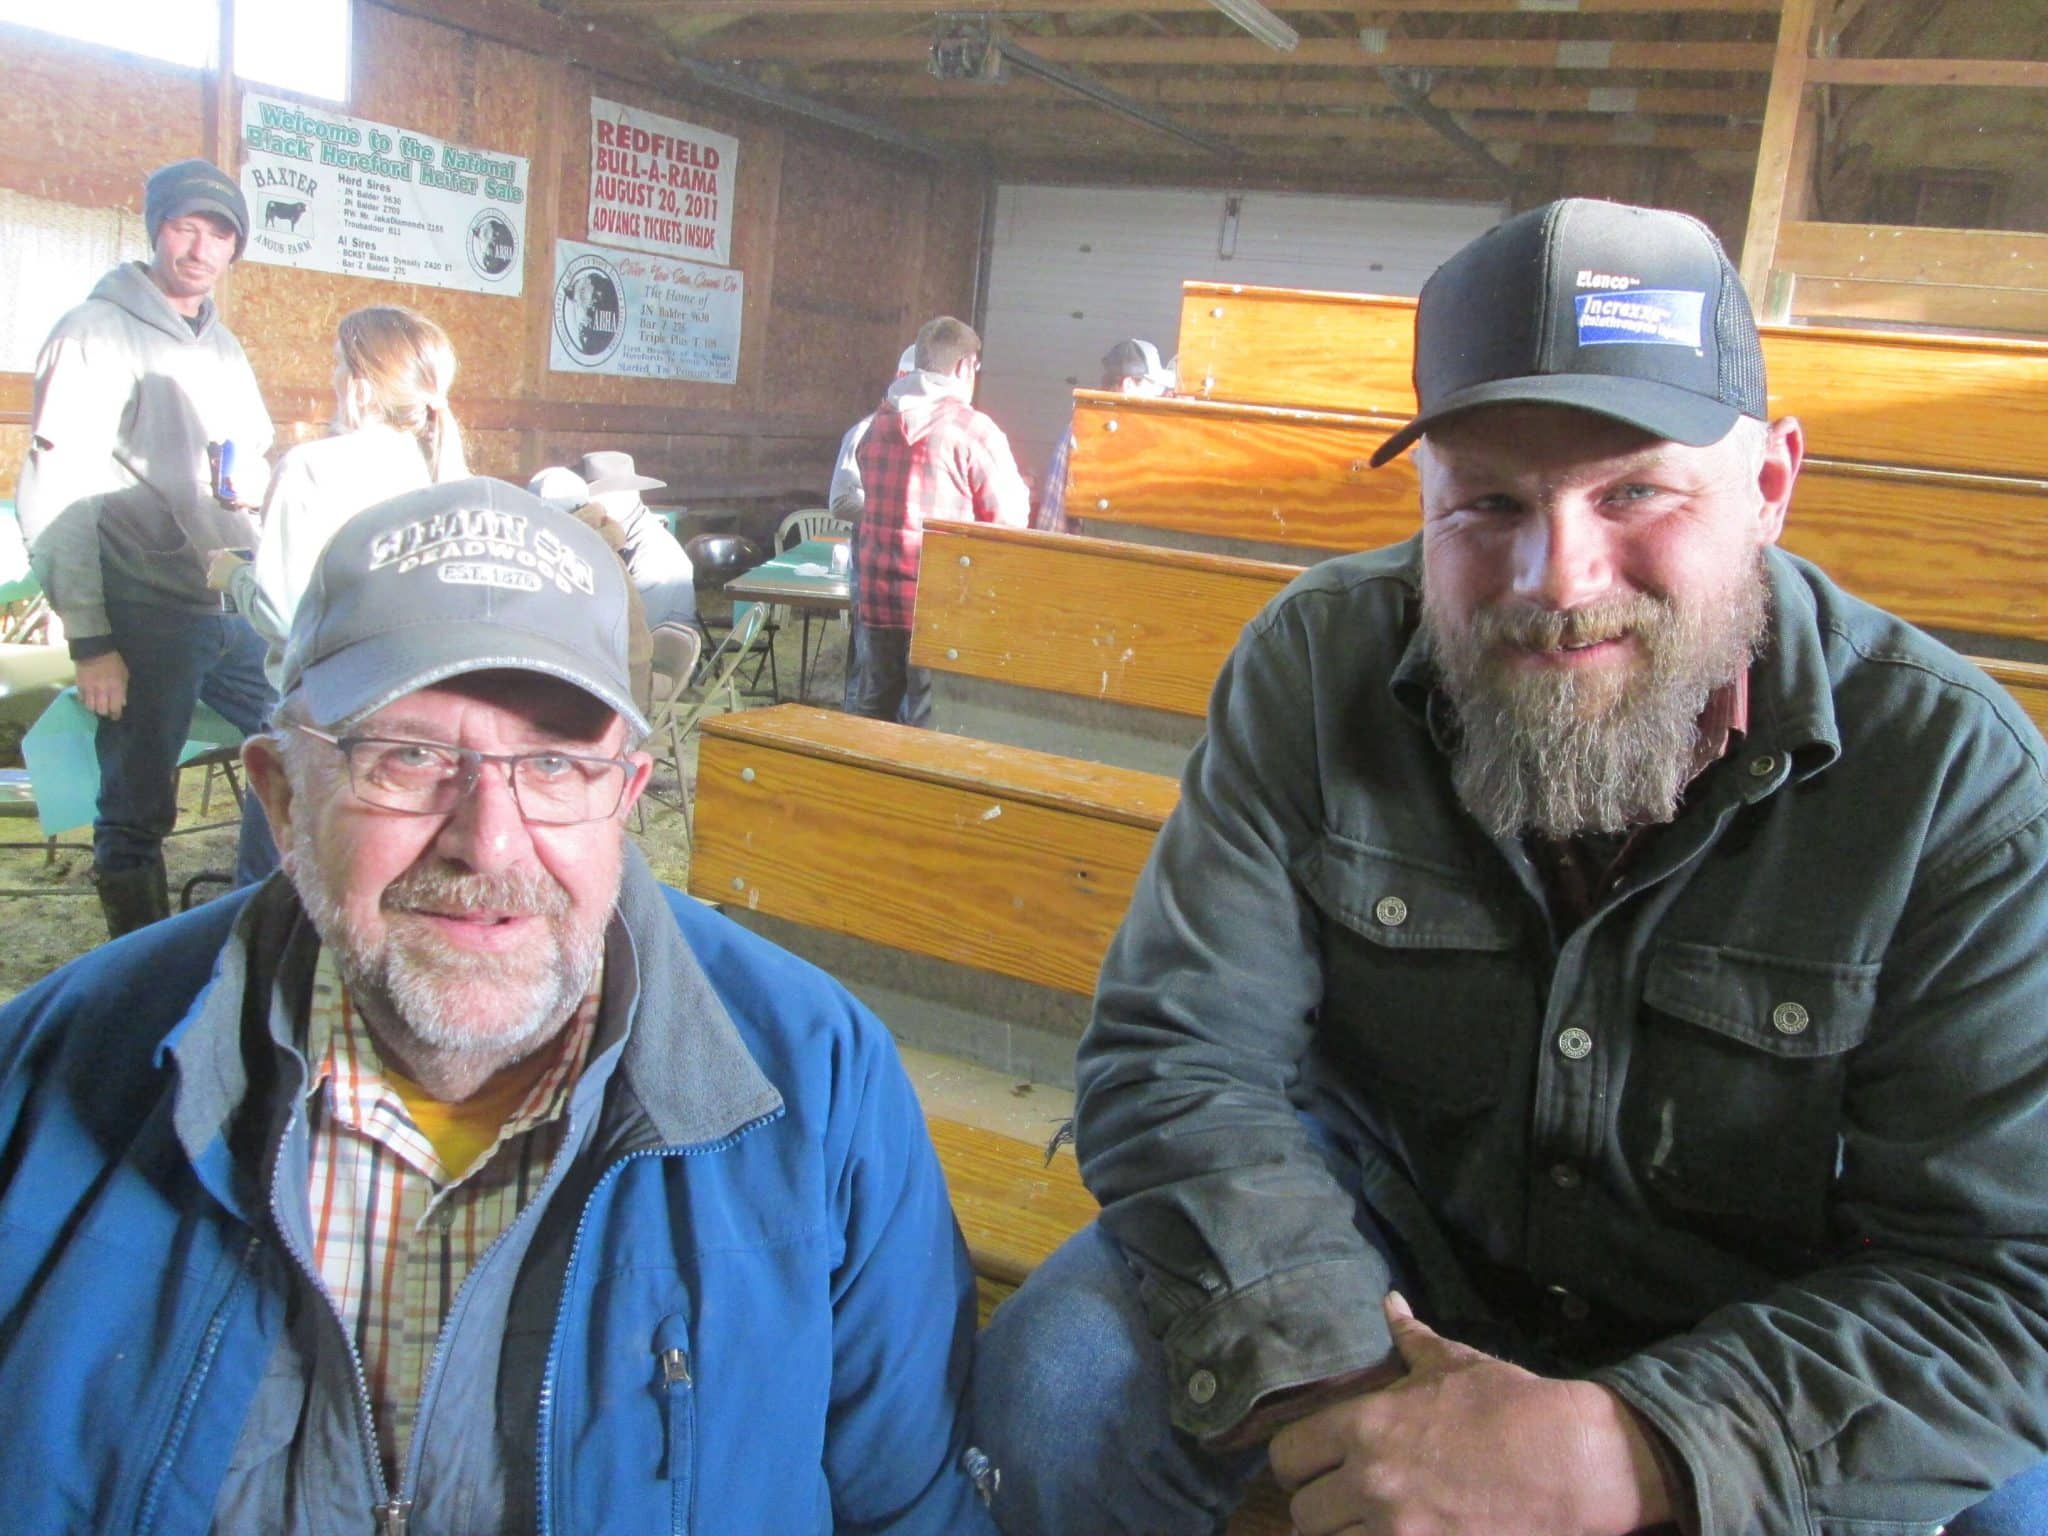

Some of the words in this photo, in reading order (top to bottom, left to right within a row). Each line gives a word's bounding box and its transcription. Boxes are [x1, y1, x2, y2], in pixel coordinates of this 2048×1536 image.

[259, 102, 361, 146] Welcome
[369, 129, 392, 153] to
[400, 136, 434, 161] the
[442, 146, 516, 182] National
[597, 119, 720, 171] REDFIELD
[247, 125, 314, 162] Black
[320, 141, 412, 182] Hereford
[420, 163, 478, 195] Heifer
[484, 177, 524, 204] Sale
[252, 167, 317, 198] BAXTER
[337, 174, 362, 188] Herd
[367, 179, 391, 193] Sires
[596, 147, 717, 196] BULL-A-RAMA
[595, 176, 654, 208] AUGUST
[658, 188, 680, 217] 20,
[685, 194, 717, 221] 2011
[352, 237, 377, 250] Sires
[593, 207, 640, 238] ADVANCE
[644, 216, 682, 244] TICKETS
[684, 224, 715, 250] INSIDE
[644, 285, 662, 298] The
[665, 289, 694, 305] Home
[698, 292, 711, 311] of
[592, 310, 618, 332] ABHA
[398, 541, 573, 594] DEADWOOD
